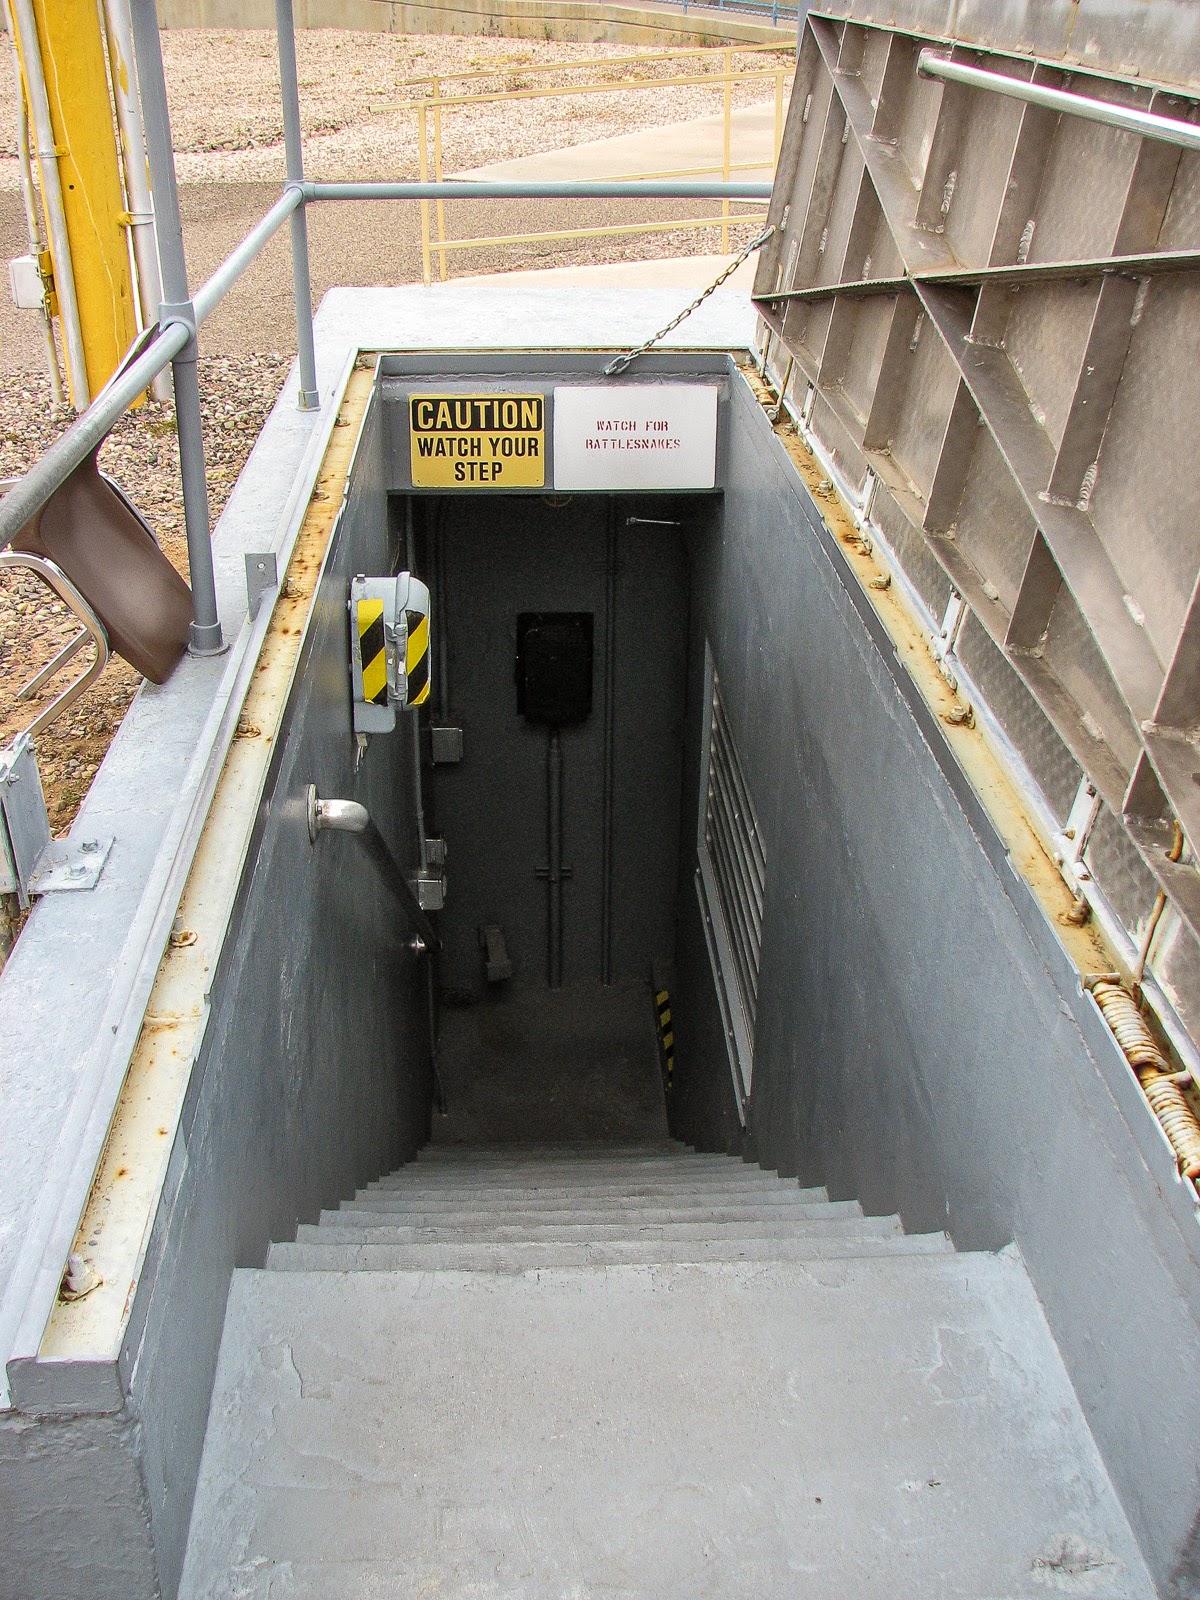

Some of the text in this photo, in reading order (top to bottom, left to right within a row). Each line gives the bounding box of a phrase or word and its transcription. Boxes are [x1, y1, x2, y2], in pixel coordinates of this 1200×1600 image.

[417, 400, 538, 430] CAUTION
[596, 420, 669, 431] WATCH FOR
[417, 437, 539, 458] WATCH YOUR
[585, 439, 681, 449] RATTLESNAKES
[454, 461, 503, 481] STEP
